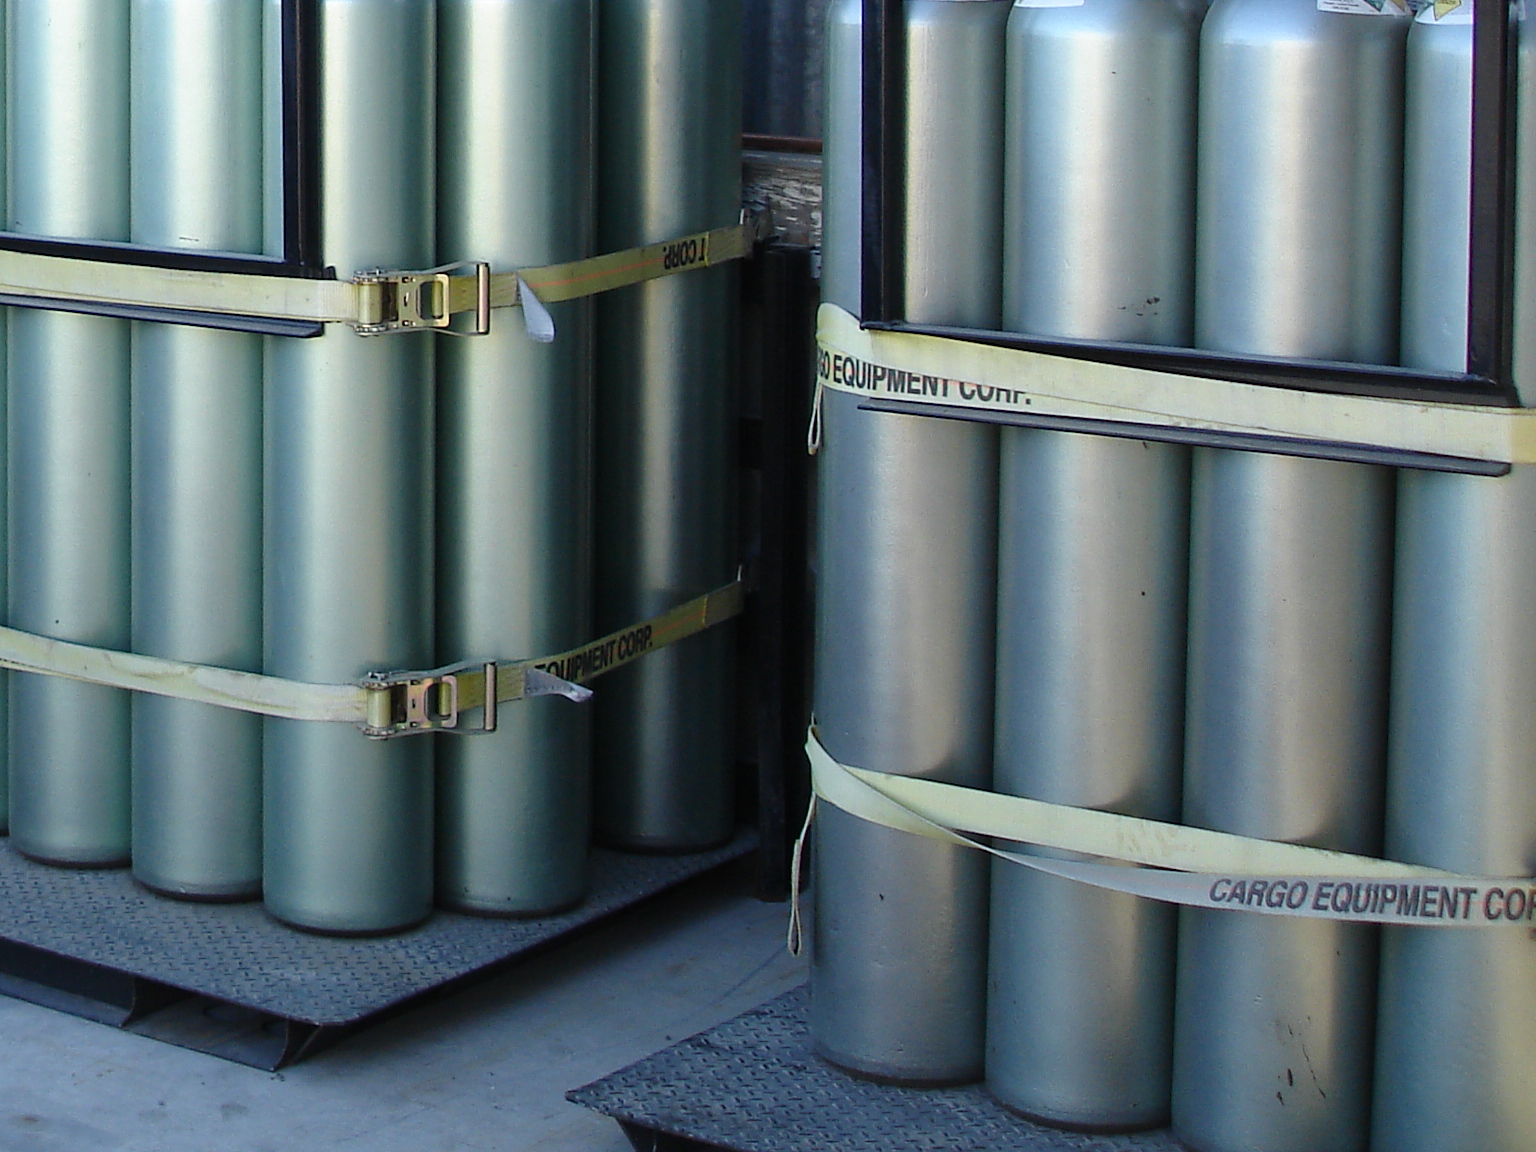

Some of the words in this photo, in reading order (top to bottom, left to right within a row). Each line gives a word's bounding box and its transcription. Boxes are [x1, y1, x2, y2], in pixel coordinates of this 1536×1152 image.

[833, 354, 948, 397] EQUIPMENT
[535, 639, 616, 682] UIPMENT
[617, 625, 653, 660] CORP.
[1209, 878, 1309, 910] CARGO
[1311, 881, 1478, 919] EQUIPMENT
